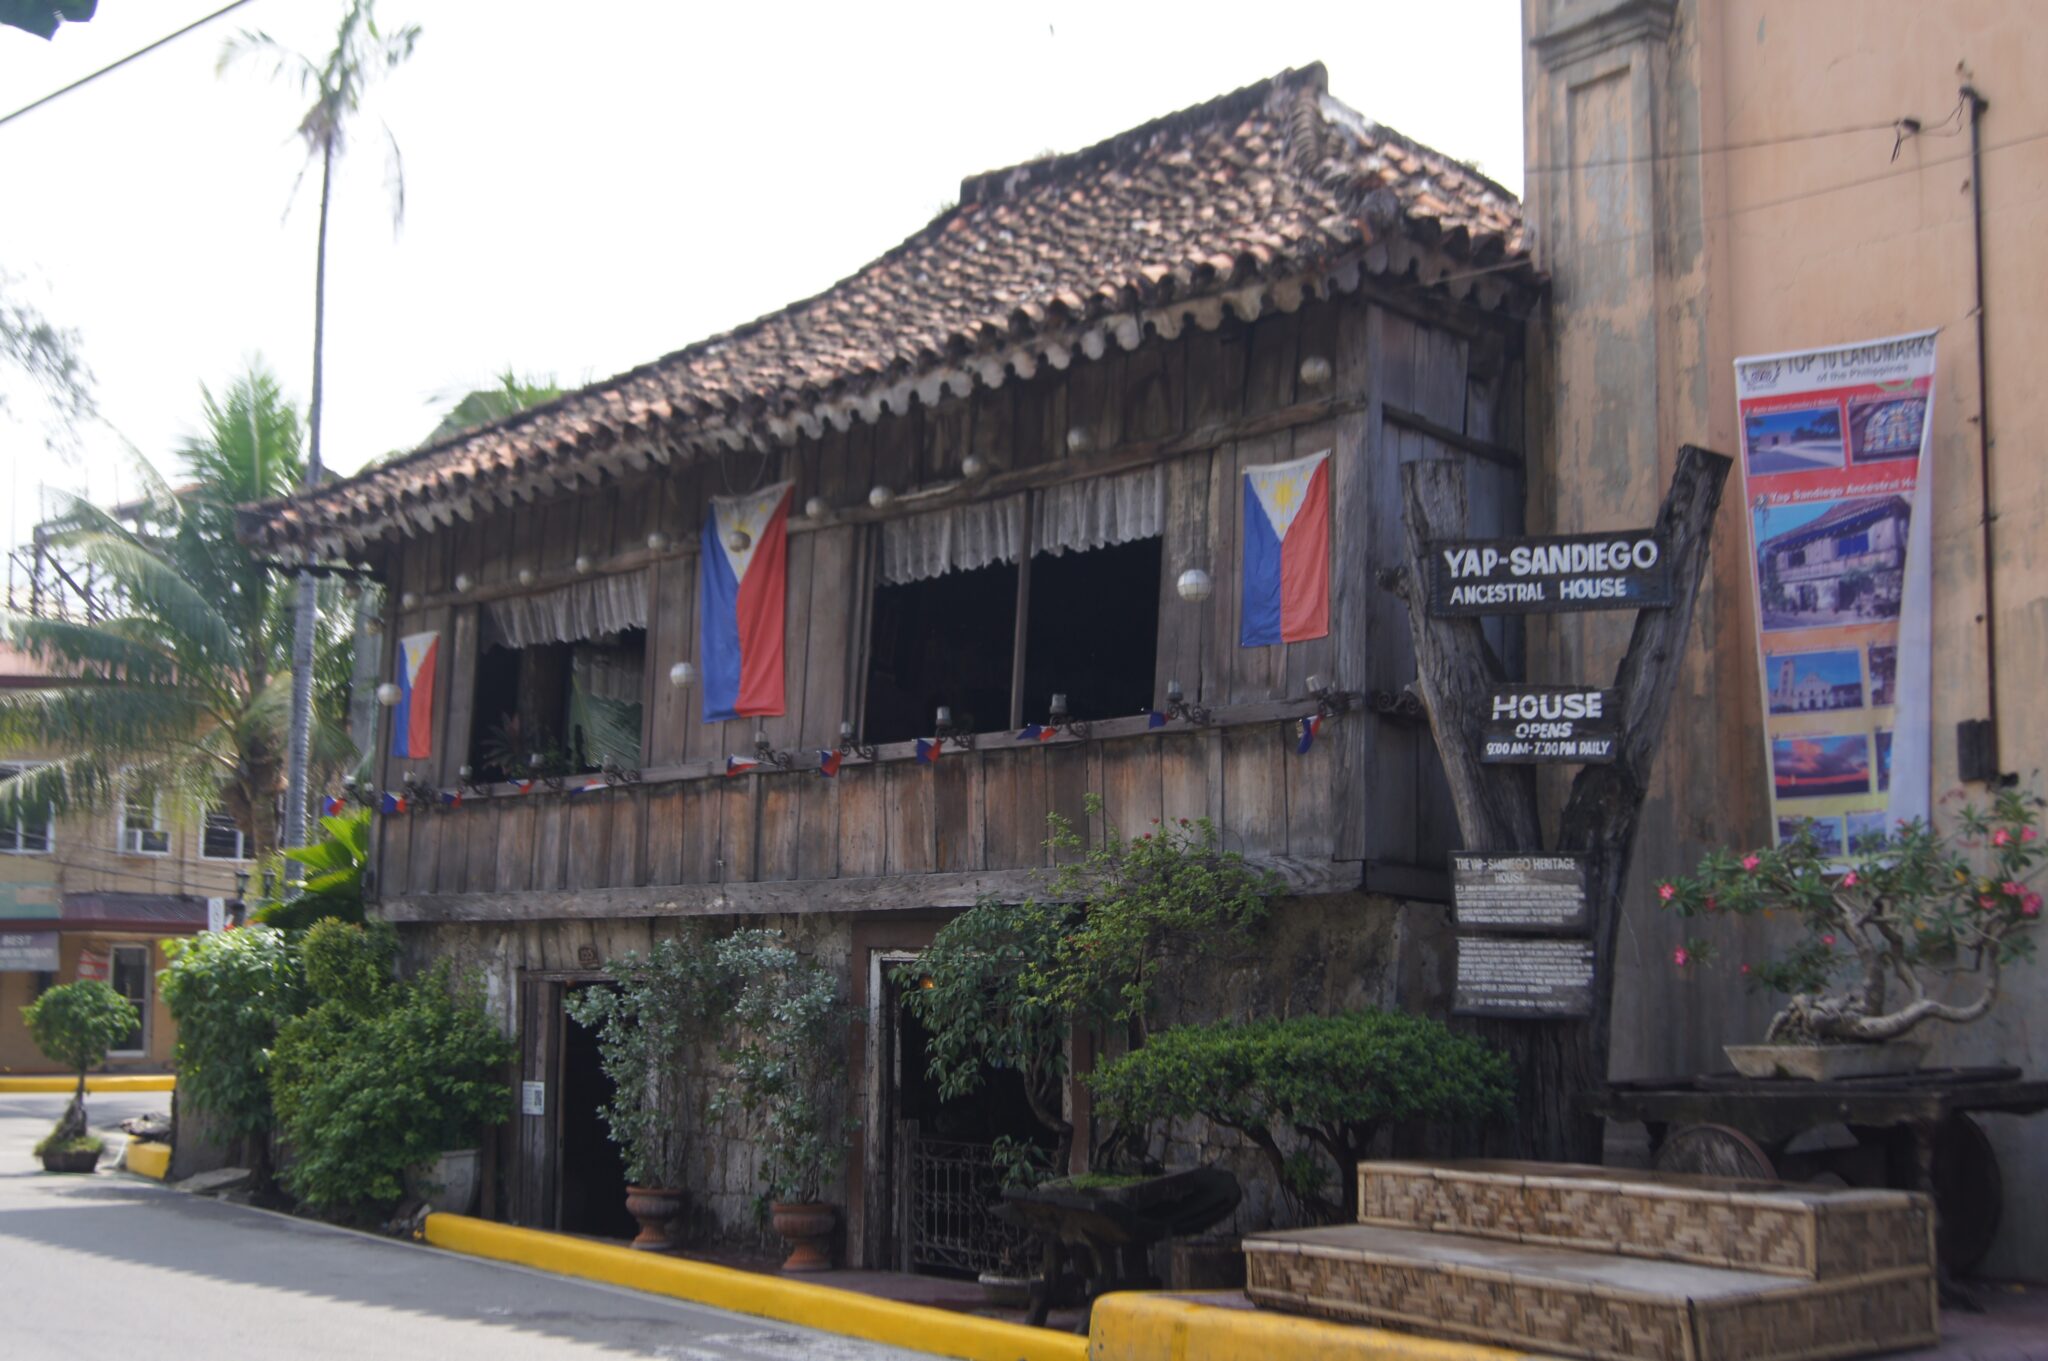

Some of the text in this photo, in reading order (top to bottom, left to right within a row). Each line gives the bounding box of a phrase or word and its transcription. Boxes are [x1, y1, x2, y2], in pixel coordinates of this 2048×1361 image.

[1787, 354, 1815, 374] TOP
[1450, 577, 1628, 605] ANCESTRAL HOUSE
[1491, 692, 1603, 721] HOUSE
[1514, 722, 1574, 740] OPENS
[1579, 740, 1612, 755] DAILY
[1533, 857, 1576, 870] HERITAGE
